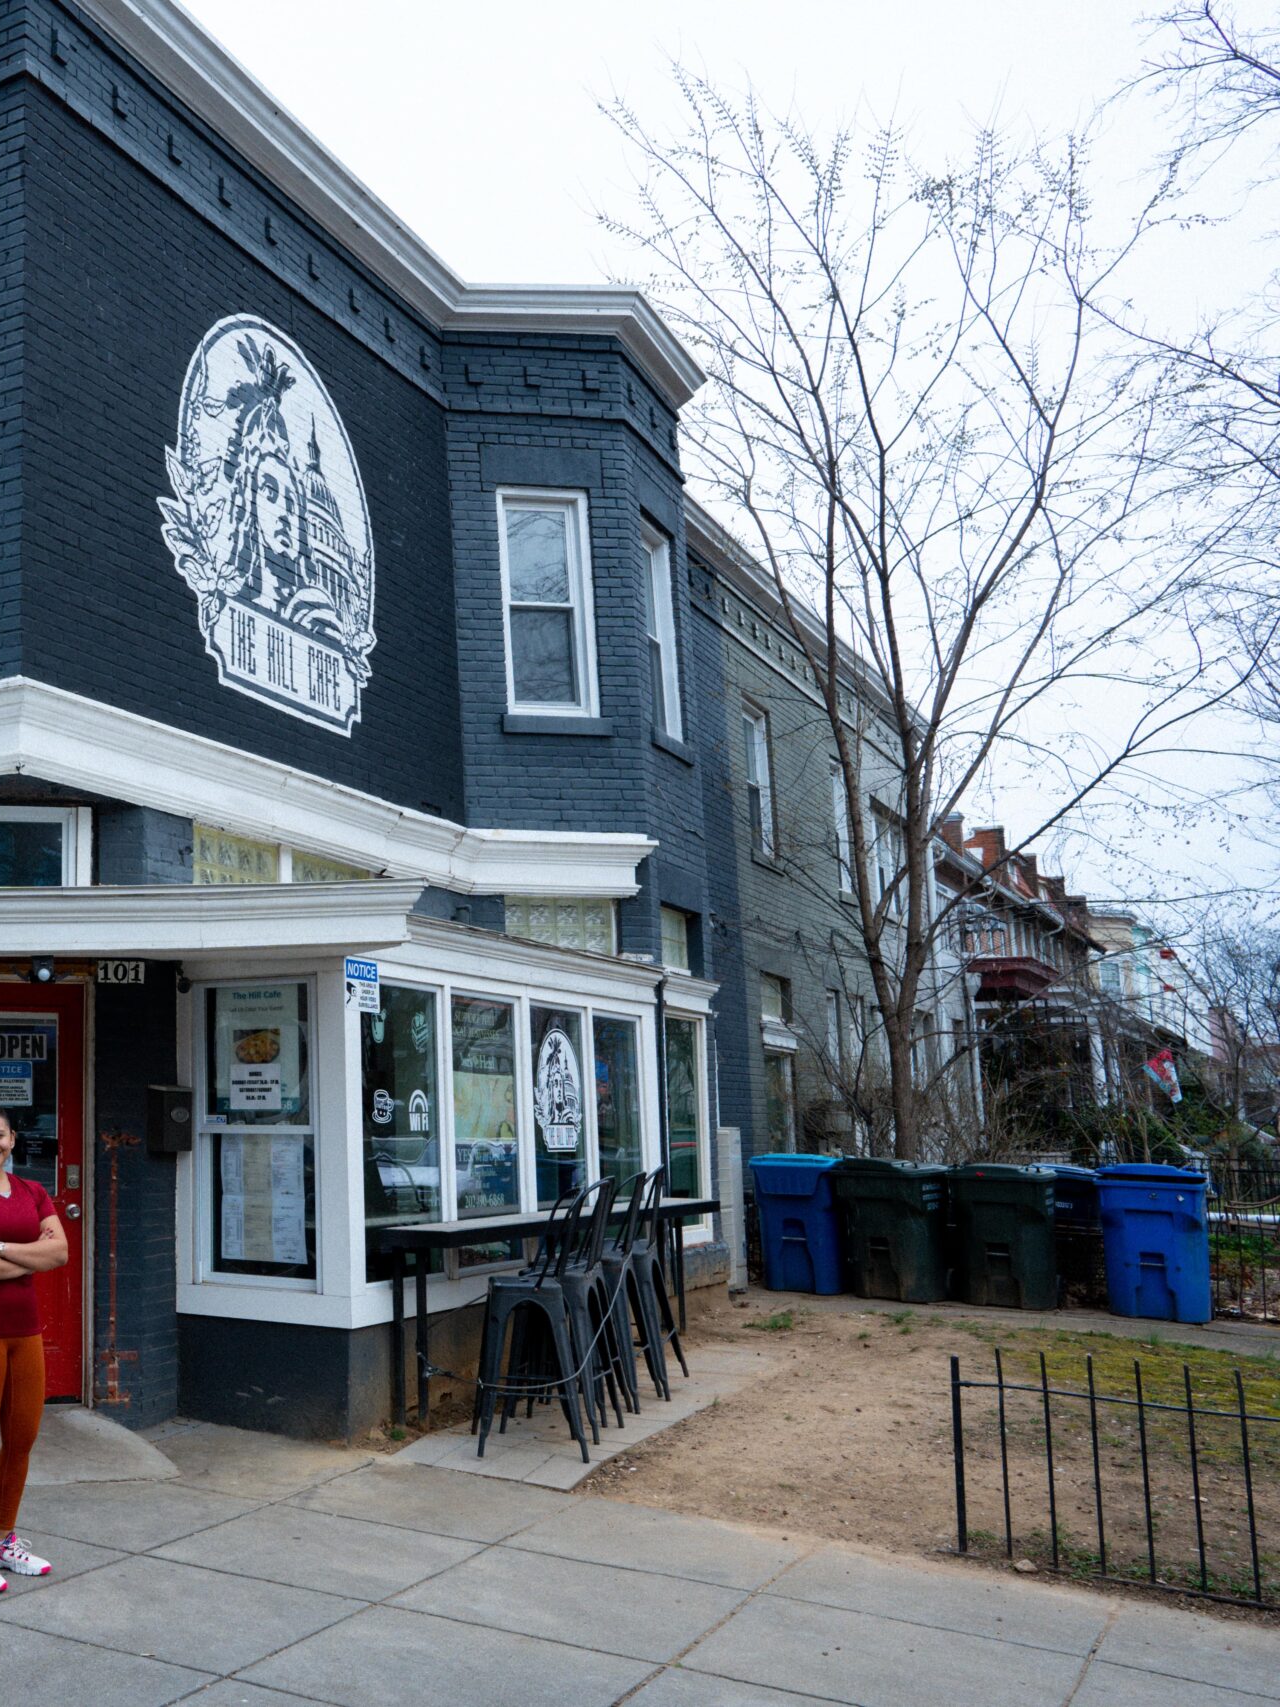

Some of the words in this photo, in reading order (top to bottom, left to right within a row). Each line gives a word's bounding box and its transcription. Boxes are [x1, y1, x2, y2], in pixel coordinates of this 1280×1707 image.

[229, 606, 256, 675] THE
[267, 625, 298, 693] HILL
[308, 644, 341, 712] CAFE
[99, 963, 142, 982] 101
[347, 962, 377, 979] NOTICE
[232, 992, 247, 1000] The
[248, 991, 261, 999] Hill
[263, 990, 282, 999] Cafe
[409, 1113, 421, 1131] Wi
[422, 1113, 429, 1131] Fi
